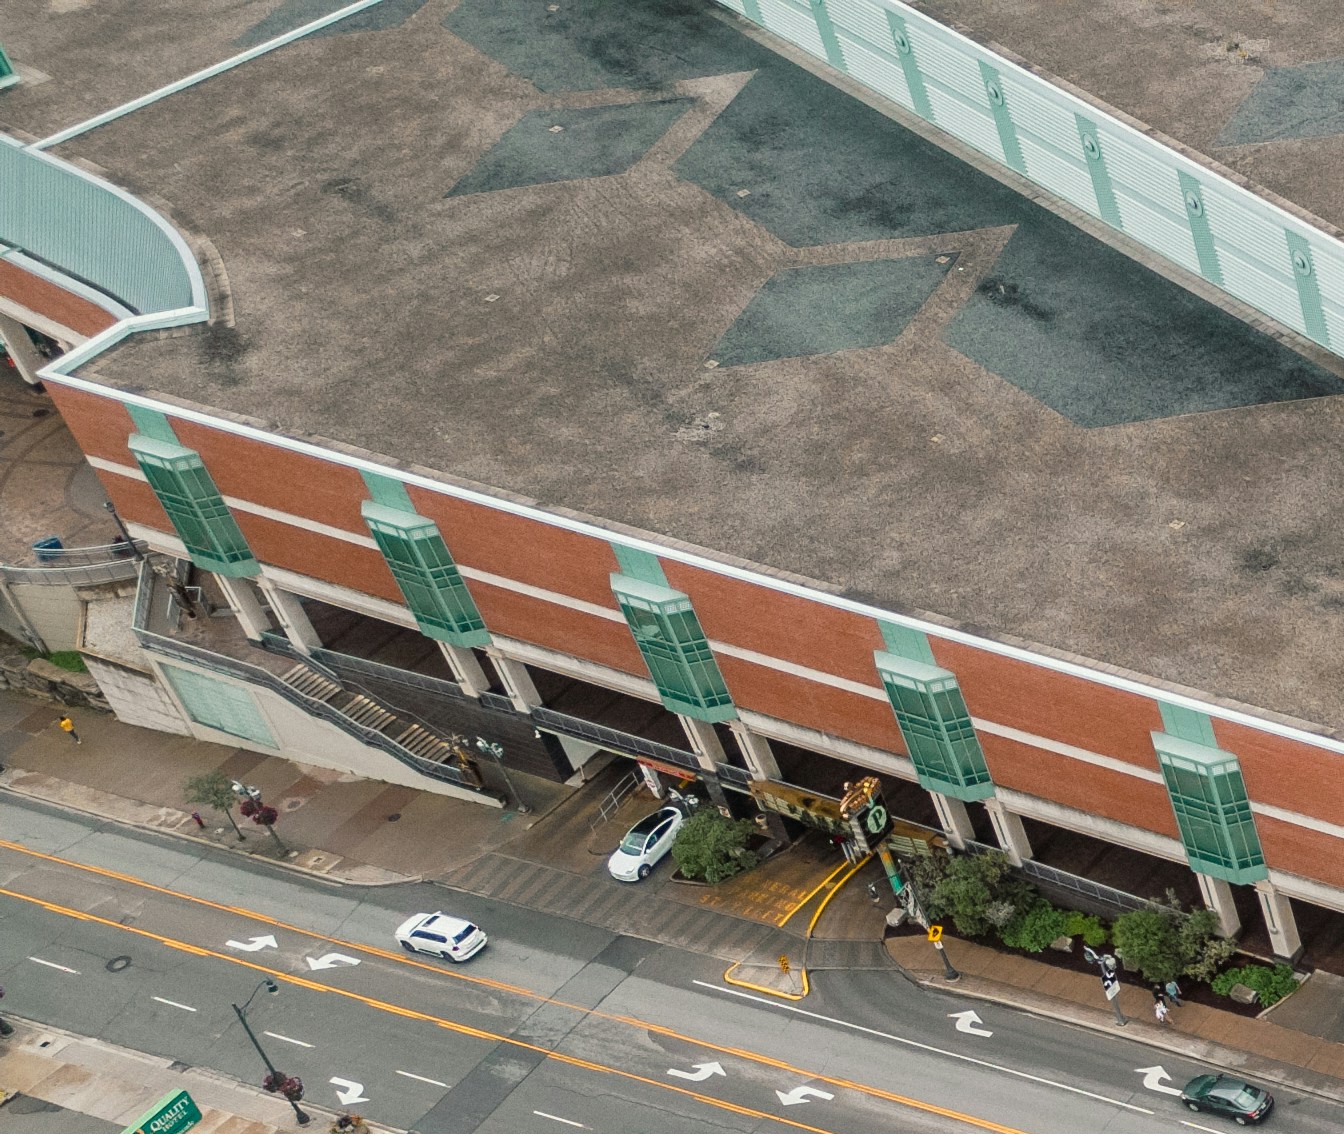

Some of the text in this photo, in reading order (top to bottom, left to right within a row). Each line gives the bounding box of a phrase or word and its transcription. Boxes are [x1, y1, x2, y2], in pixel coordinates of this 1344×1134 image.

[872, 808, 883, 831] P
[150, 1096, 190, 1132] QUALITY
[162, 1110, 188, 1132] HOTEL
